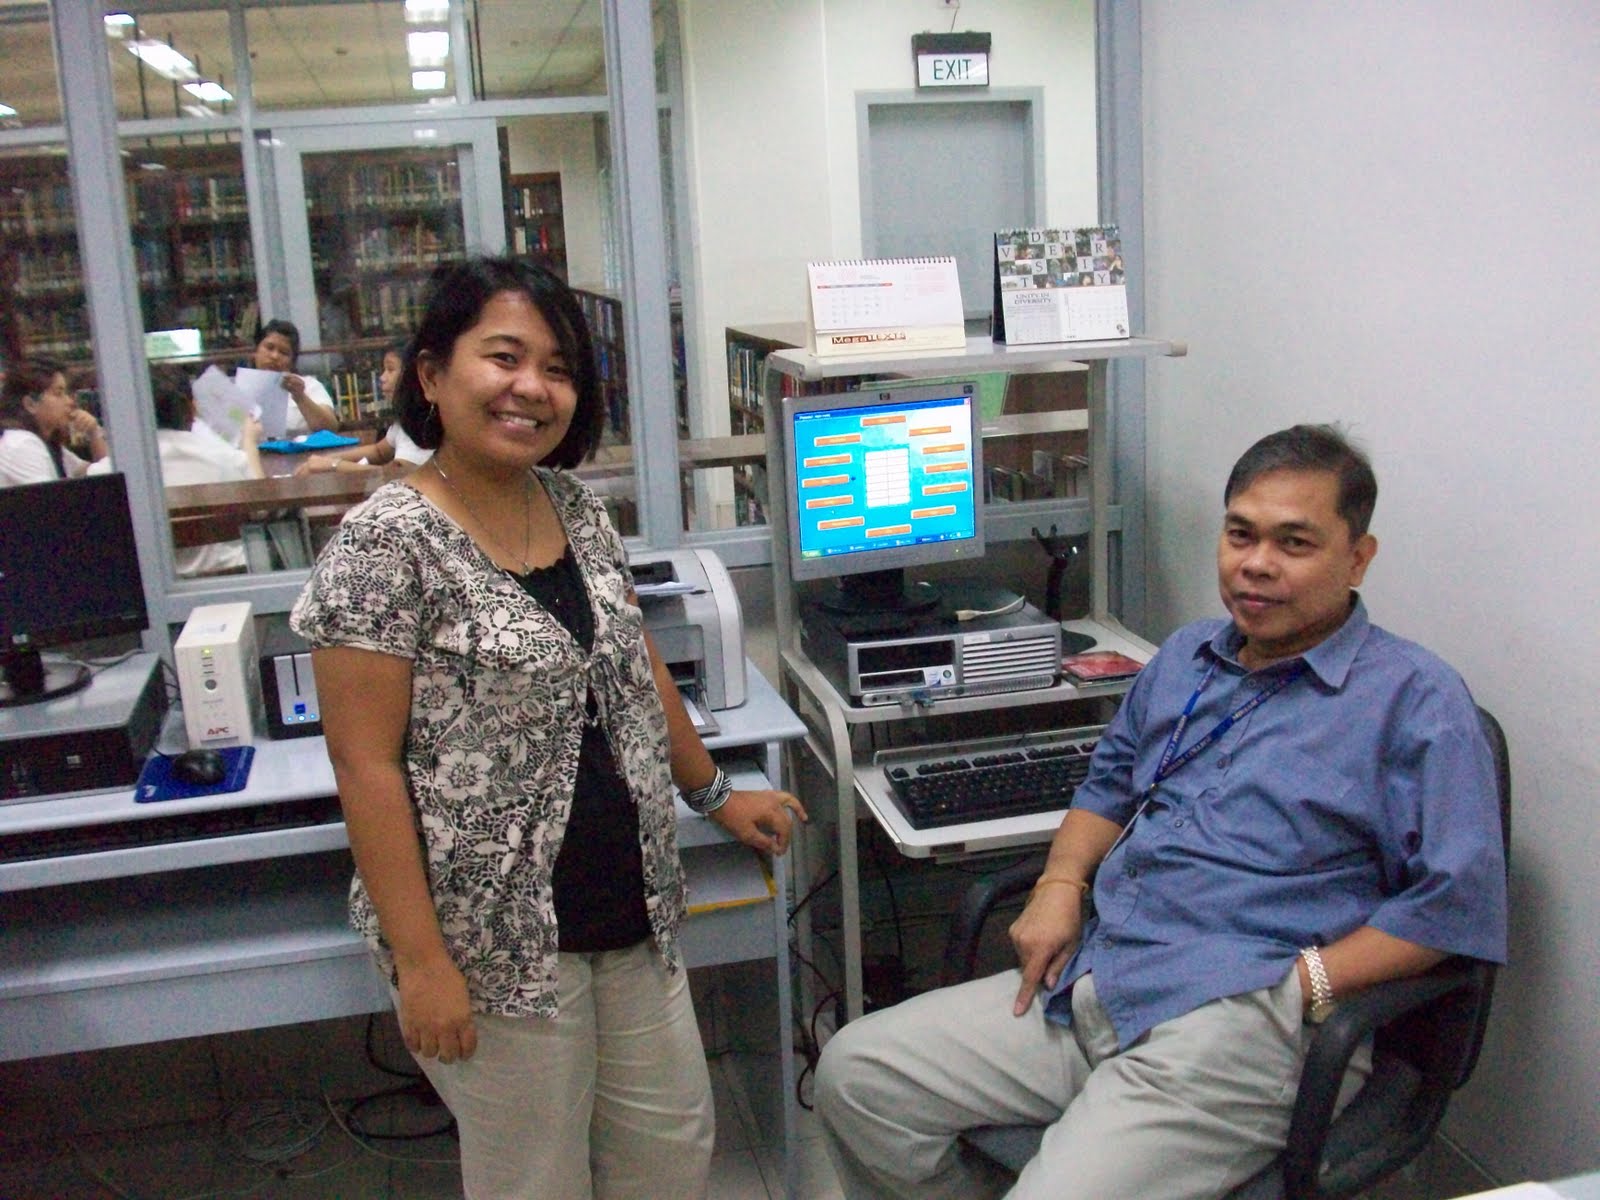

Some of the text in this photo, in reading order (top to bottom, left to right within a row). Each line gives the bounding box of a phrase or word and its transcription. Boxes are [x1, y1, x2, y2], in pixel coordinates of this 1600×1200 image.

[933, 59, 972, 80] EXIT
[1031, 231, 1041, 242] D
[1001, 243, 1104, 258] V E R
[1035, 262, 1044, 273] S
[1021, 273, 1106, 288] T Y
[207, 726, 229, 735] APC
